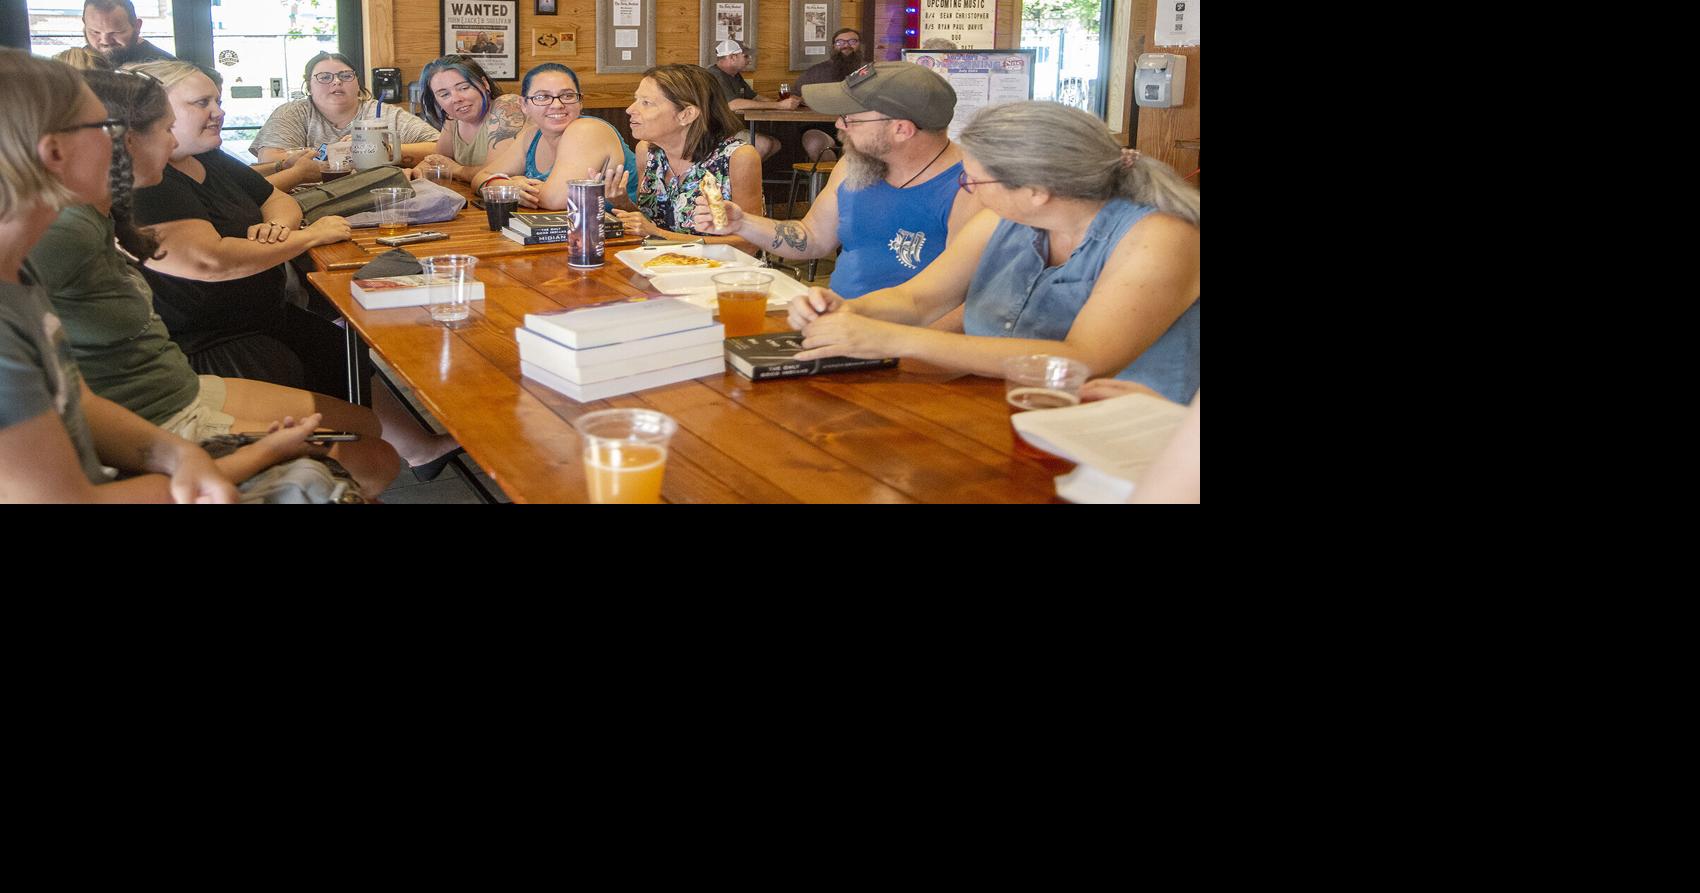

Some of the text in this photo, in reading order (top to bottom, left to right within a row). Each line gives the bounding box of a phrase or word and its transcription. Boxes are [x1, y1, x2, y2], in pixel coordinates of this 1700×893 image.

[927, 0, 985, 8] UPCOMING MUSIC
[451, 3, 508, 16] WANTED
